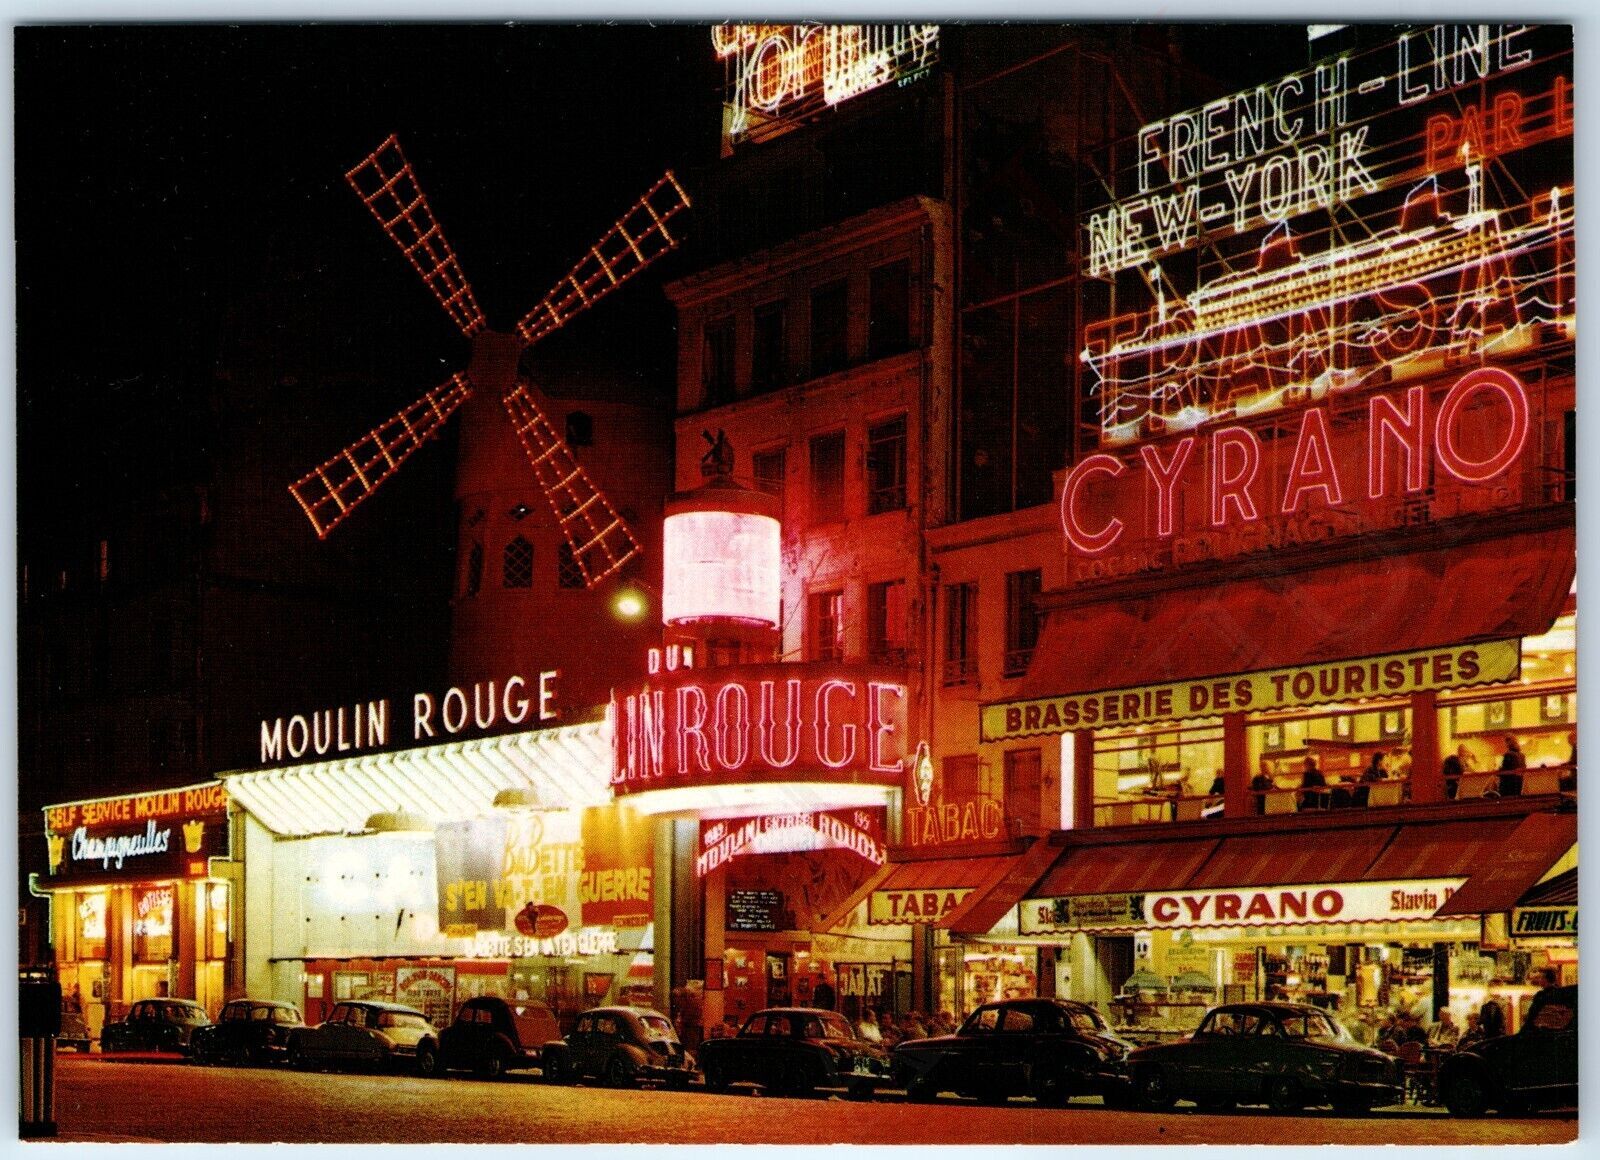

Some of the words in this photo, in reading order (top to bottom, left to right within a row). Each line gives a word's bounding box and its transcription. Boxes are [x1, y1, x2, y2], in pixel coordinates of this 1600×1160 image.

[1426, 91, 1522, 171] PAR
[1088, 125, 1378, 275] NEW-YORK
[1060, 366, 1529, 553] CYRANO
[260, 699, 389, 764] MOULIN
[414, 670, 560, 741] ROUGE
[676, 679, 904, 775] ROUGE
[1005, 687, 1173, 734] BRASSERIE
[1188, 680, 1253, 713] DES
[1271, 650, 1481, 702] TOURISTES
[49, 808, 76, 829] SELF
[82, 799, 131, 825] SERVICE
[134, 793, 180, 819] MOULIN
[907, 800, 999, 847] TABAC
[576, 866, 652, 904] GUERRE
[1151, 888, 1345, 924] CYRANO
[1390, 887, 1438, 911] Slavia
